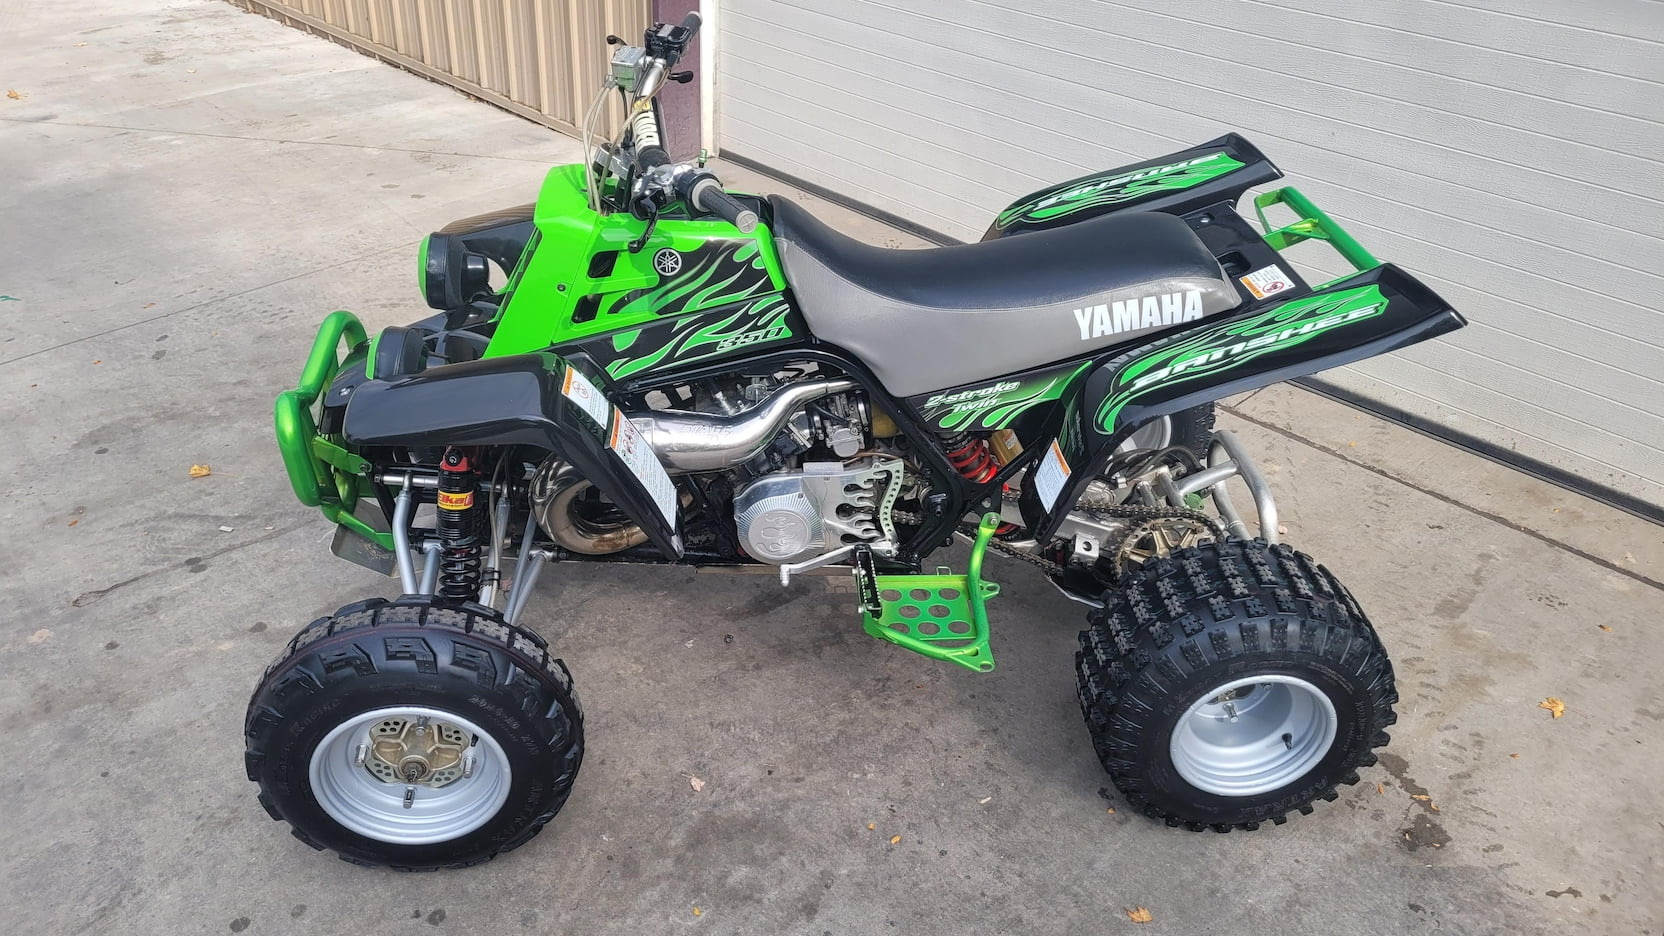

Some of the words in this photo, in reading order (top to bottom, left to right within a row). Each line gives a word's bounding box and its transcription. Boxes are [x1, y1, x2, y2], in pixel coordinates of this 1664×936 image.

[1073, 289, 1203, 341] YAMAHA
[716, 326, 785, 351] 350
[1128, 302, 1385, 392] BANSHEE
[923, 381, 1021, 409] 2-stroke
[952, 398, 998, 414] Twin
